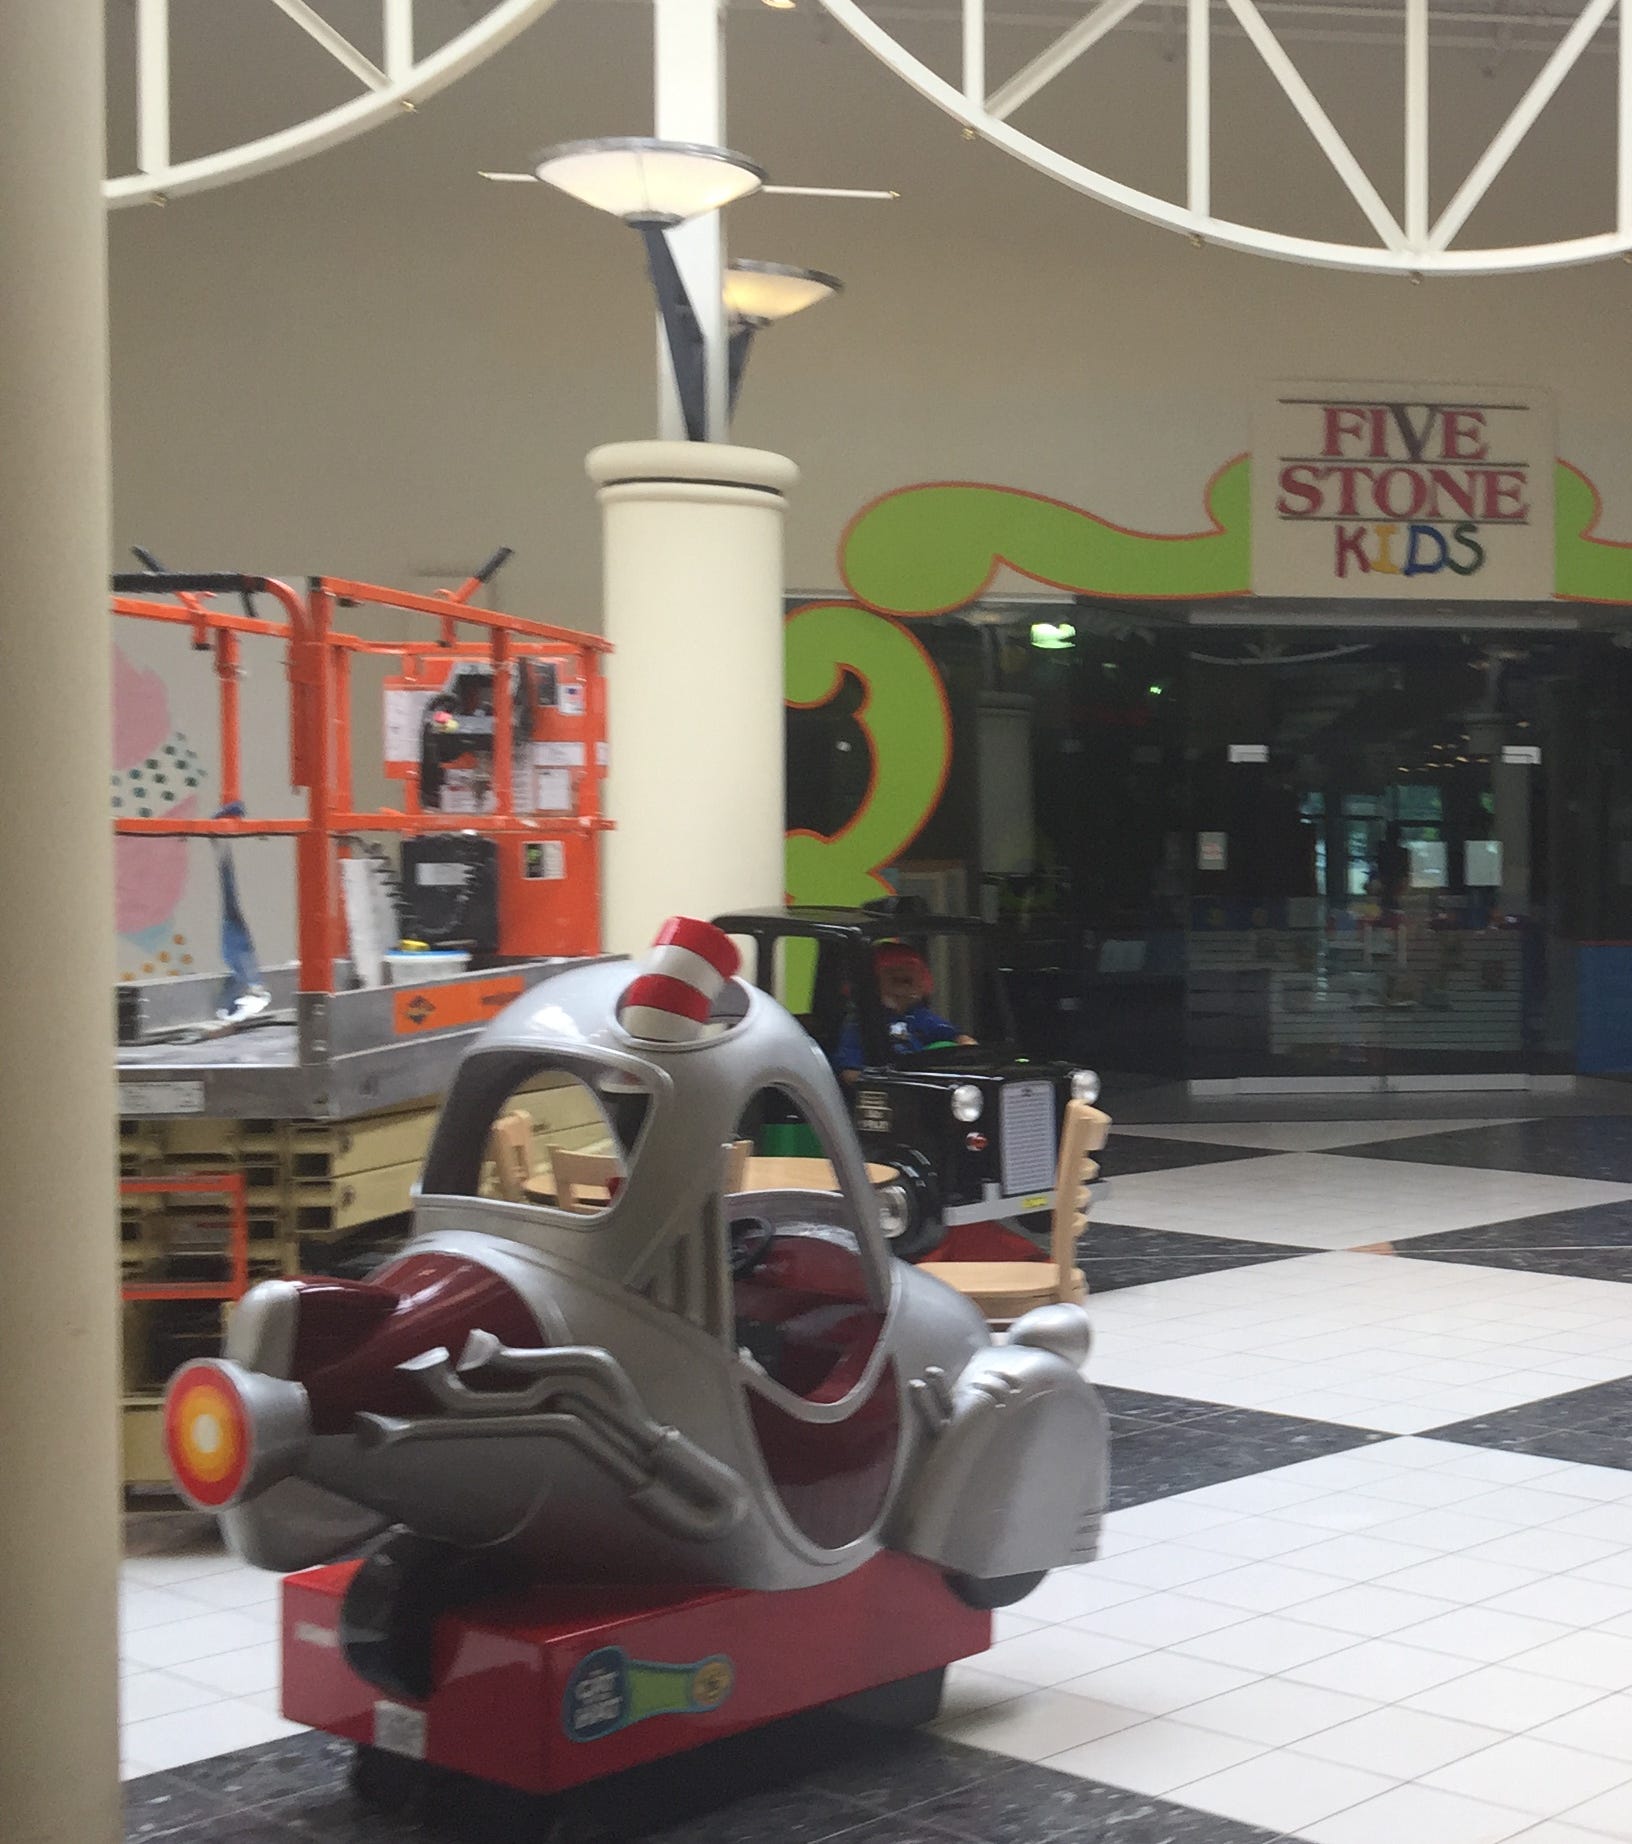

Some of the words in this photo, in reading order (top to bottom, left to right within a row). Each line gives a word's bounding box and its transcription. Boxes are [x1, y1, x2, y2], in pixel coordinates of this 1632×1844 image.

[1320, 403, 1488, 462] FIVE
[1276, 464, 1530, 519] STONE
[1333, 521, 1487, 579] KIDS
